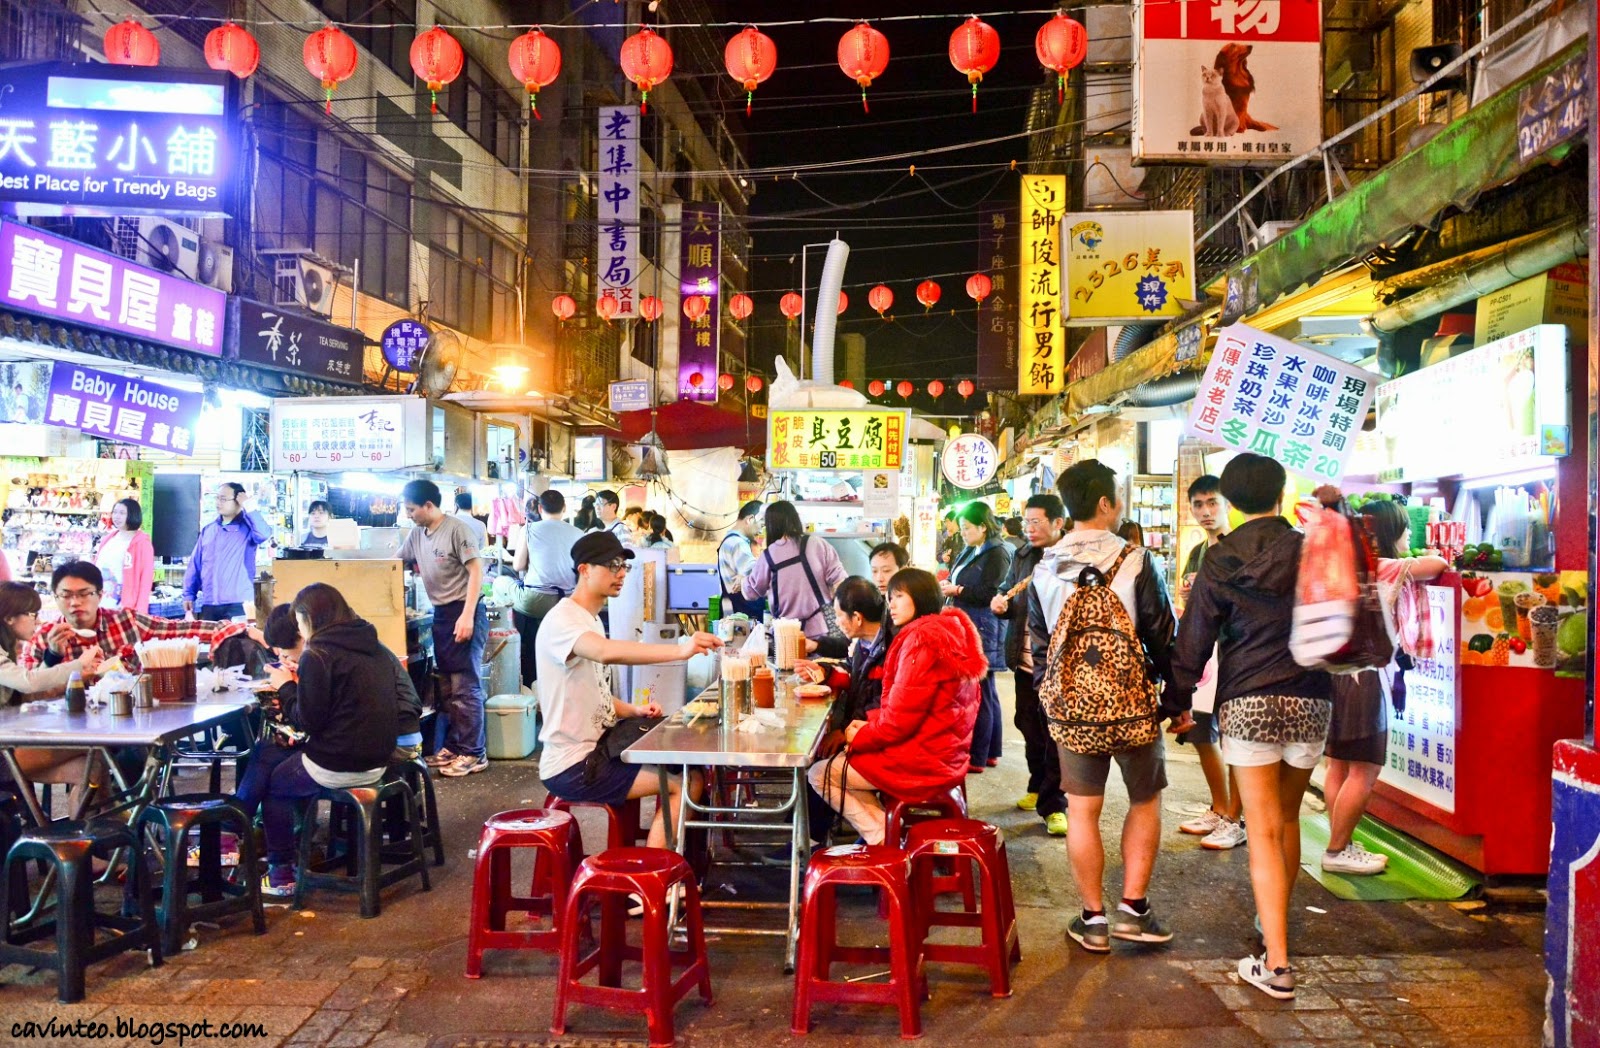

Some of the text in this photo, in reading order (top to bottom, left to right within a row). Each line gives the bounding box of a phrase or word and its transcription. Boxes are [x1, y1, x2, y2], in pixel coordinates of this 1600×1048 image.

[0, 119, 217, 175] 天藍小舖
[34, 174, 80, 191] Place
[84, 177, 108, 193] for
[113, 178, 171, 199] Trendy
[175, 181, 217, 199] Bags
[603, 110, 632, 286] 老集中書局
[8, 234, 160, 332] 寶貝屋
[619, 287, 633, 313] 文具
[1029, 209, 1059, 391] 帥俊流行男飾
[1142, 280, 1161, 307] 現炸
[319, 335, 330, 346] TEA
[71, 370, 180, 413] Baby House
[1194, 336, 1246, 434] 【傳統老店】
[1232, 342, 1276, 417] 珍珠奶茶
[1261, 354, 1306, 427] 水果冰沙
[1291, 364, 1337, 437] 咖啡冰沙
[49, 393, 147, 441] 寶貝屋
[808, 416, 883, 451] 臭豆腐
[1322, 375, 1367, 451] 現場特調
[289, 453, 301, 463] 60
[330, 452, 342, 462] 50
[370, 451, 382, 461] 60
[850, 454, 882, 467] 素食可
[972, 441, 989, 480] 燒仙草
[1221, 417, 1339, 478] 冬瓜茶 20
[1251, 964, 1262, 976] N
